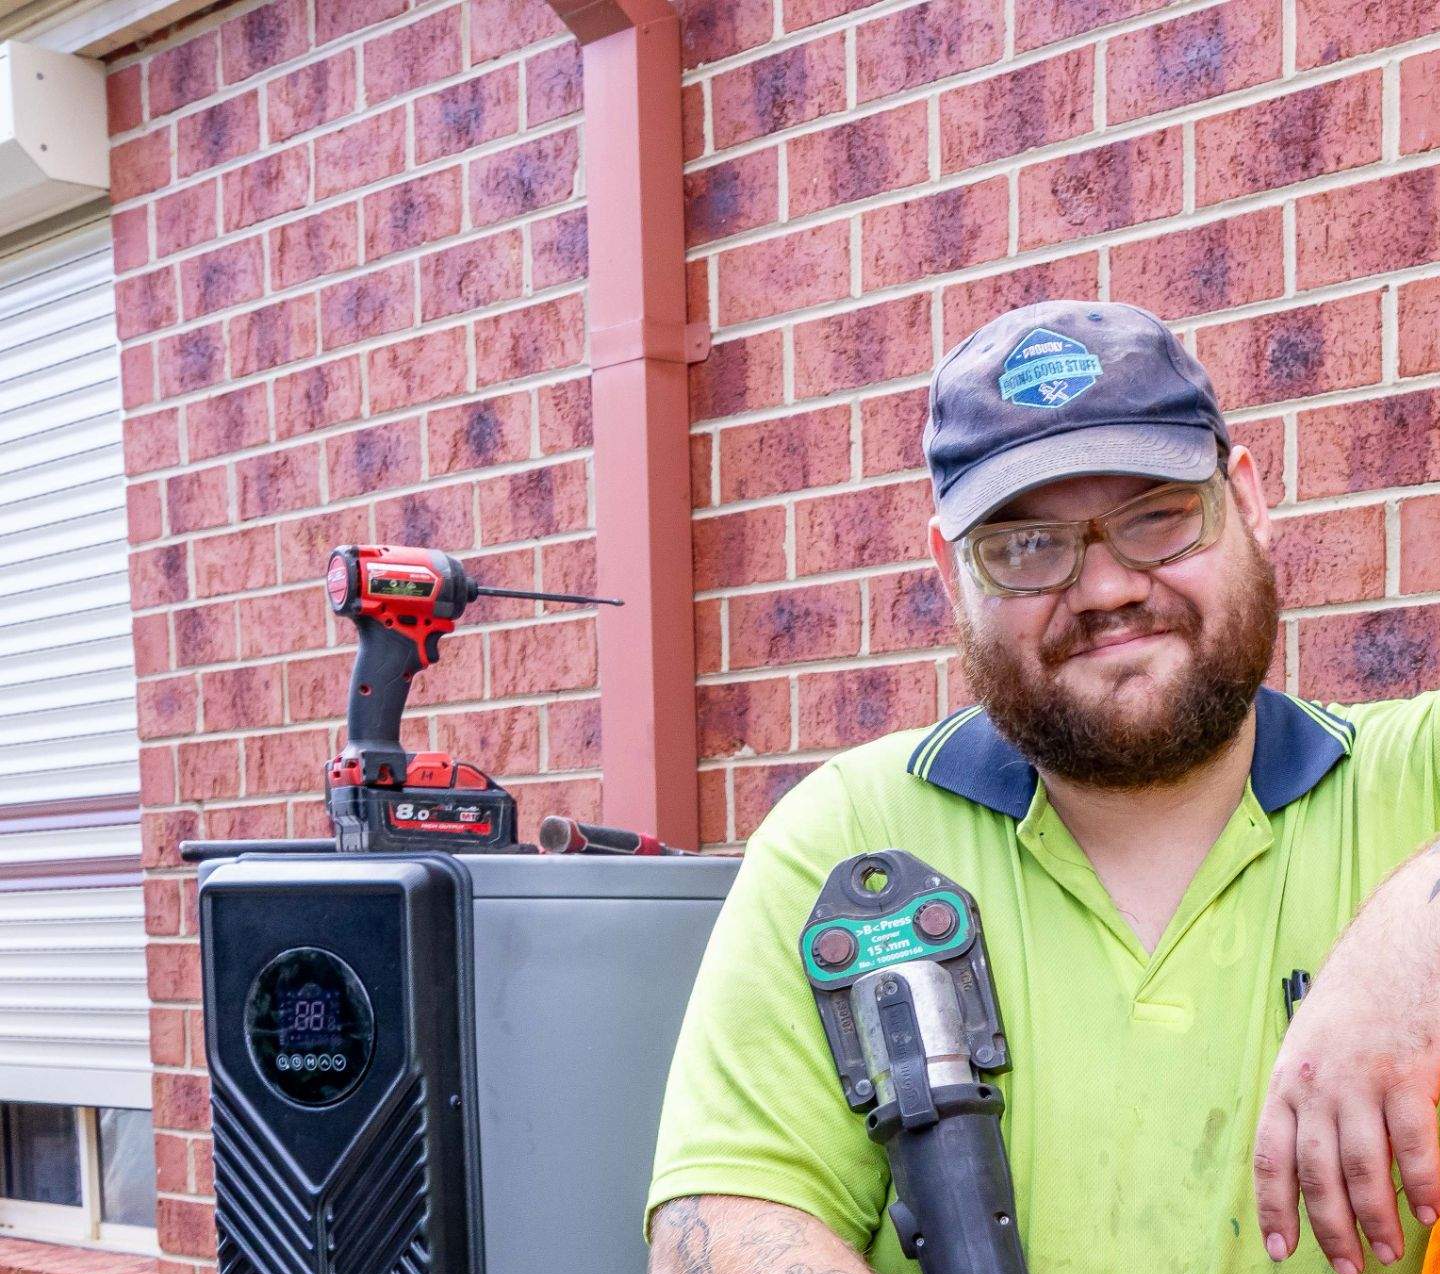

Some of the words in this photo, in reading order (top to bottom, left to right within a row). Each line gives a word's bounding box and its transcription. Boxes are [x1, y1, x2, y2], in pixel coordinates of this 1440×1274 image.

[1033, 361, 1063, 380] GOOD
[1065, 359, 1097, 373] STUFF
[395, 803, 430, 821] 8.0
